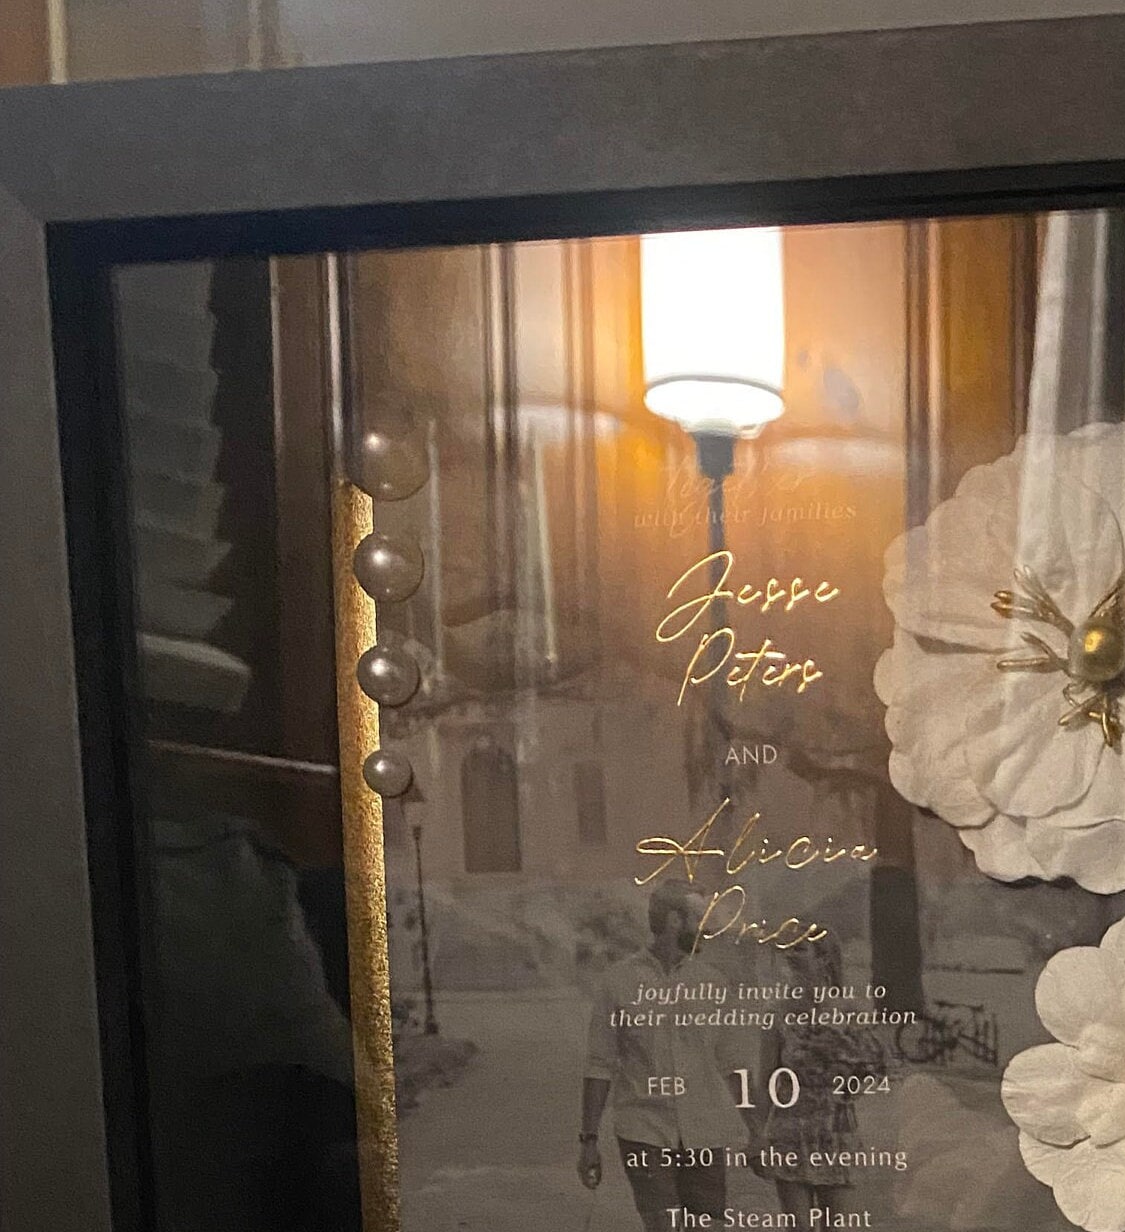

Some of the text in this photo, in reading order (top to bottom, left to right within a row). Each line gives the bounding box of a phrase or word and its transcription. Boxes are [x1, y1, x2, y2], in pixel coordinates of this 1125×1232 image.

[760, 500, 858, 526] families
[655, 550, 841, 642] Jesse
[677, 627, 824, 706] Peters
[725, 745, 778, 765] AND
[634, 797, 878, 884] Alicia
[689, 885, 828, 961] Price
[632, 982, 887, 1006] joyfully invite you to
[610, 1008, 917, 1031] their wedding celebration
[648, 1067, 891, 1109] FEB 10 2024
[626, 1146, 909, 1171] at 5:30 in the evening
[665, 1207, 872, 1229] The Steam Plant
